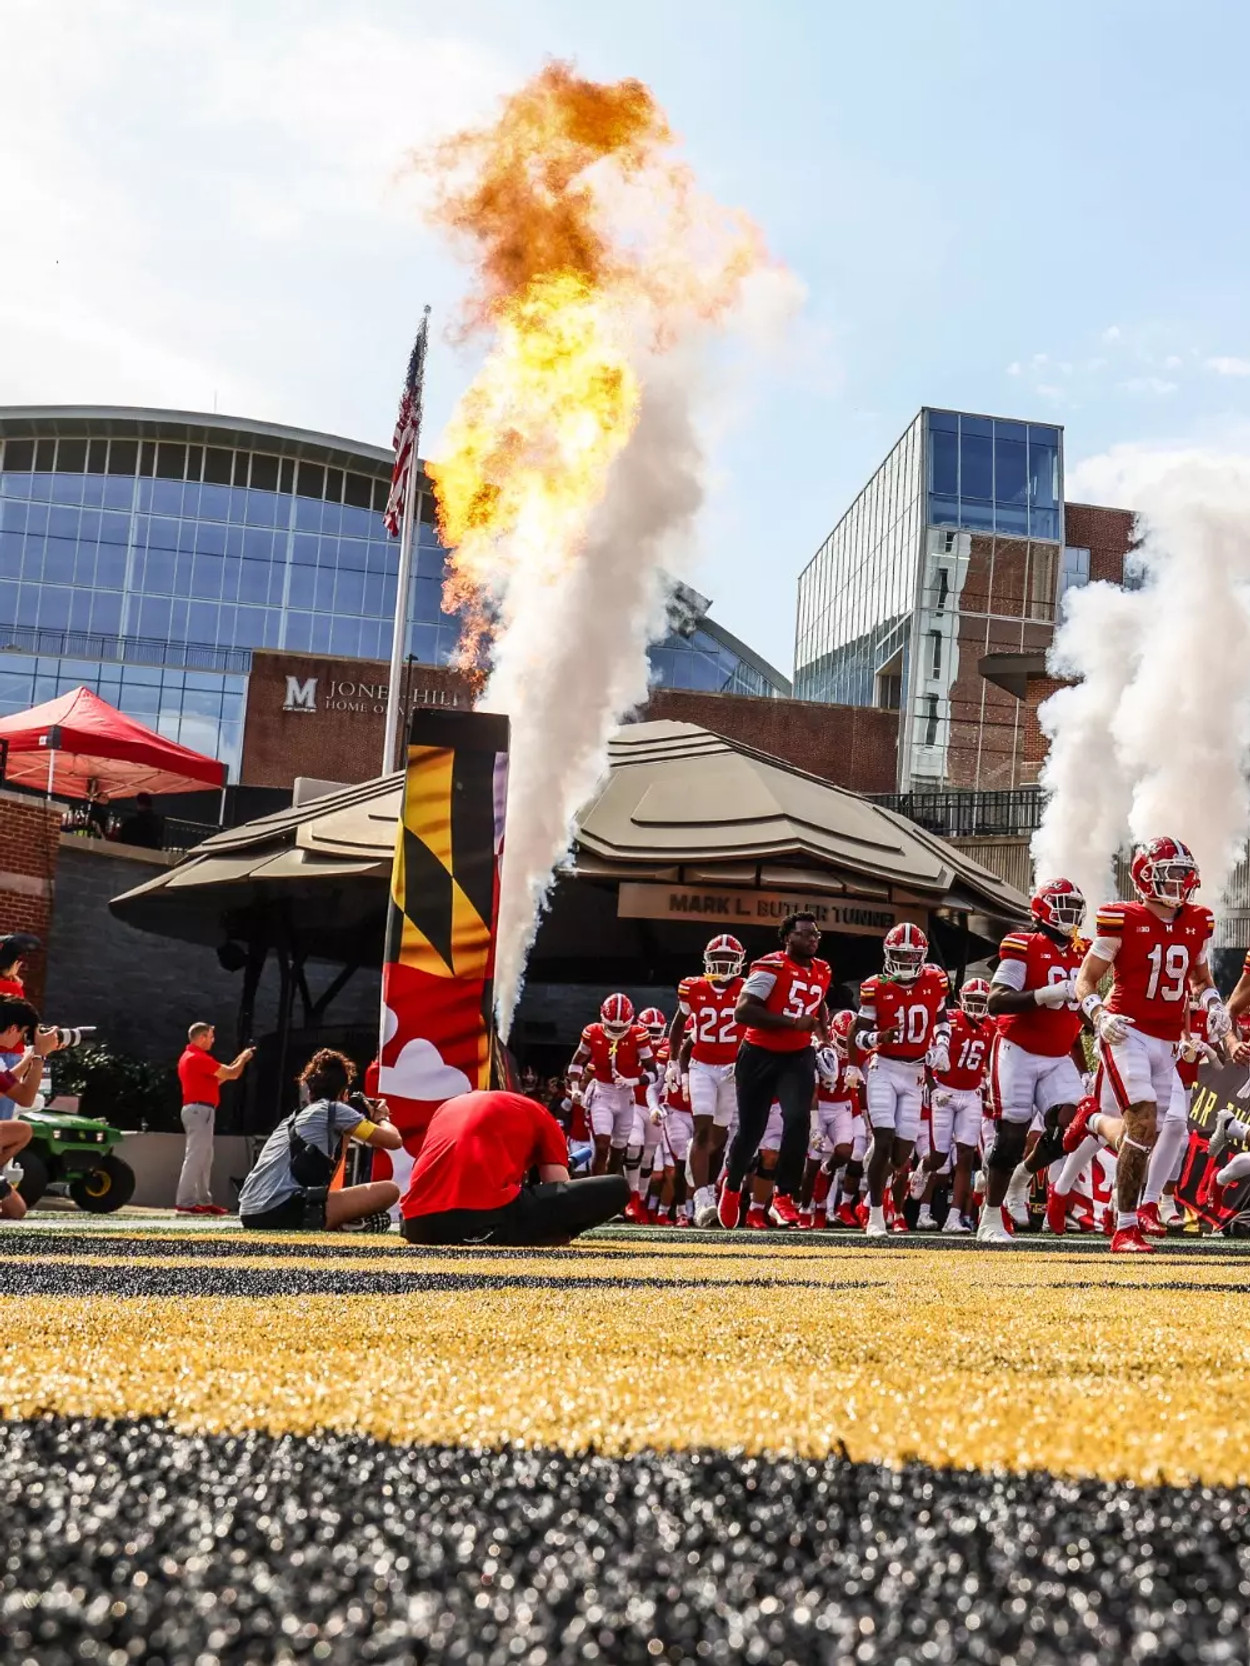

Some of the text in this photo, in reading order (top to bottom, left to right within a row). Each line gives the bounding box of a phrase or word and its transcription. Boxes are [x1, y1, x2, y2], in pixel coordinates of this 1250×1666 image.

[283, 675, 319, 707] M
[325, 701, 368, 714] HOME
[668, 893, 730, 914] MARK
[736, 897, 752, 916] L.
[1146, 943, 1190, 1002] 19
[783, 979, 823, 1019] 52
[699, 1007, 738, 1043] 22
[892, 1003, 929, 1045] 10
[956, 1038, 986, 1071] 16
